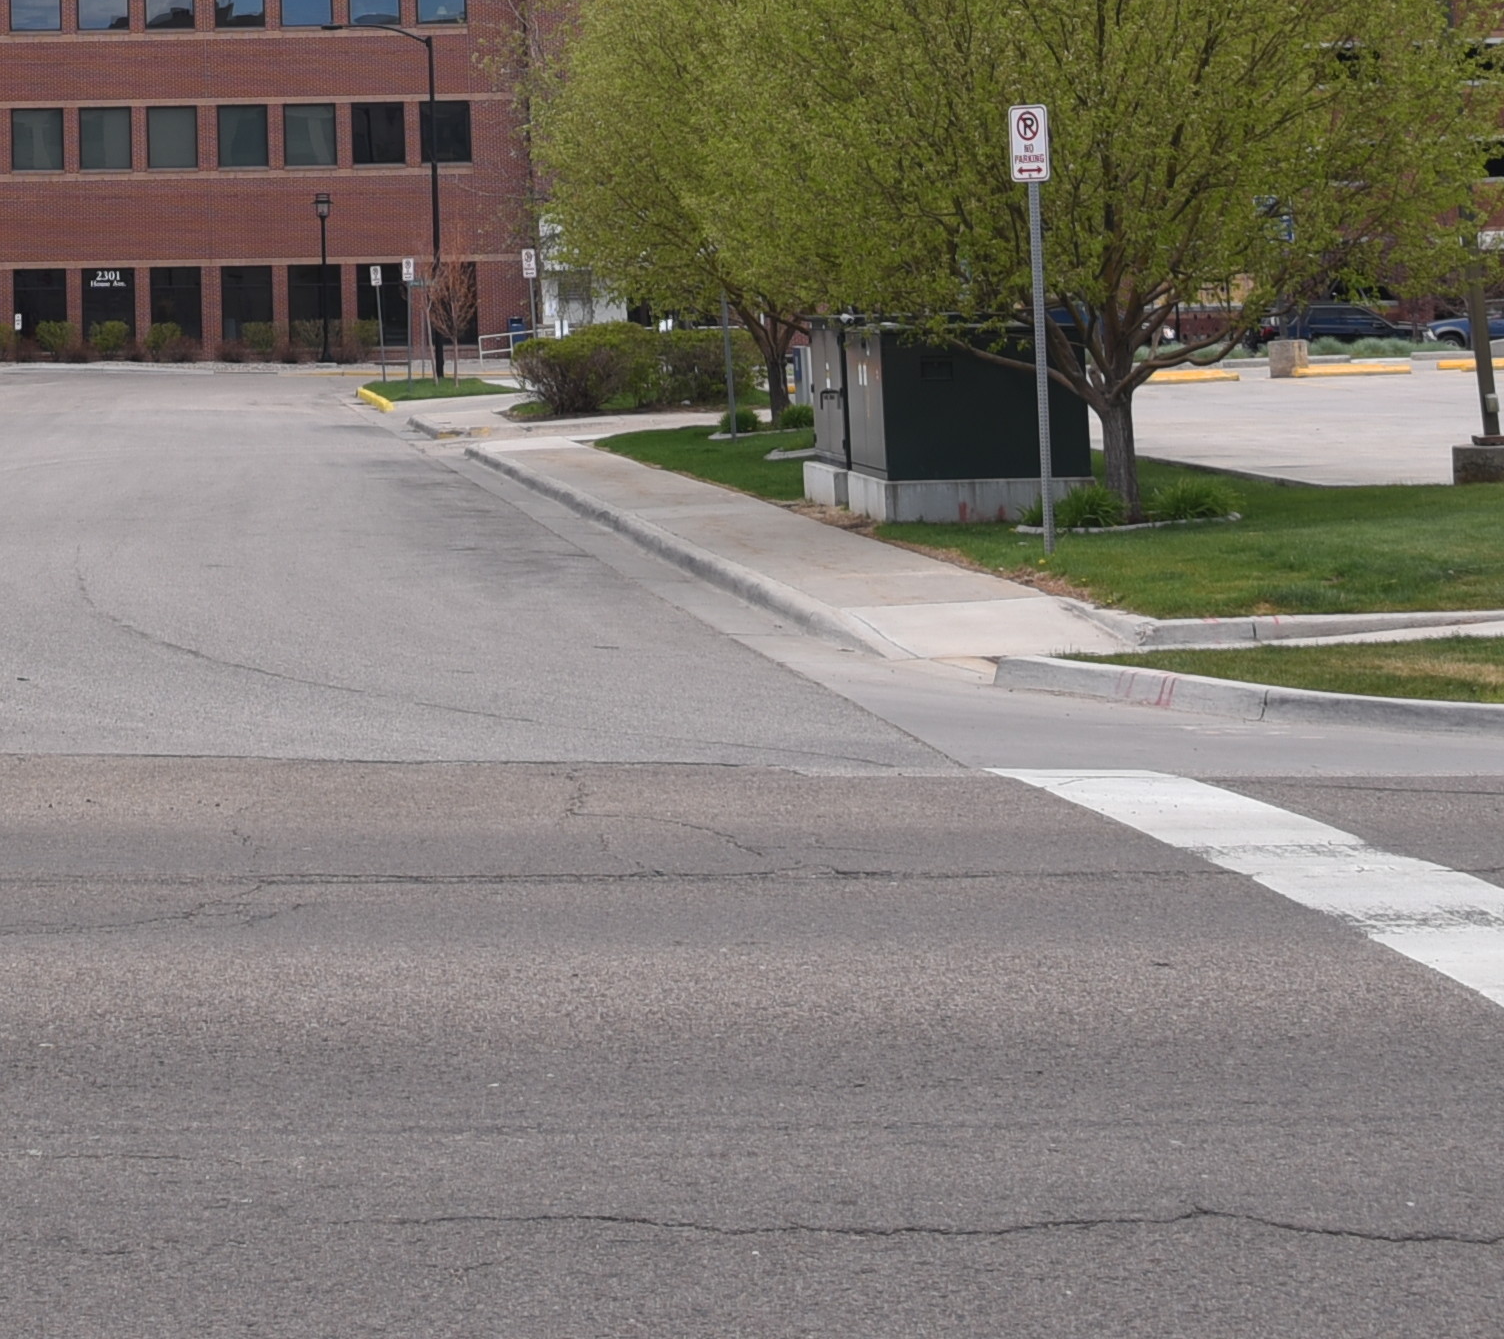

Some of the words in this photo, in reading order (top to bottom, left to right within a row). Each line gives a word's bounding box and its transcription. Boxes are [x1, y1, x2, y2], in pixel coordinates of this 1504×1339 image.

[1024, 144, 1034, 153] NO
[1014, 154, 1045, 164] PARKING
[96, 271, 120, 280] 2301
